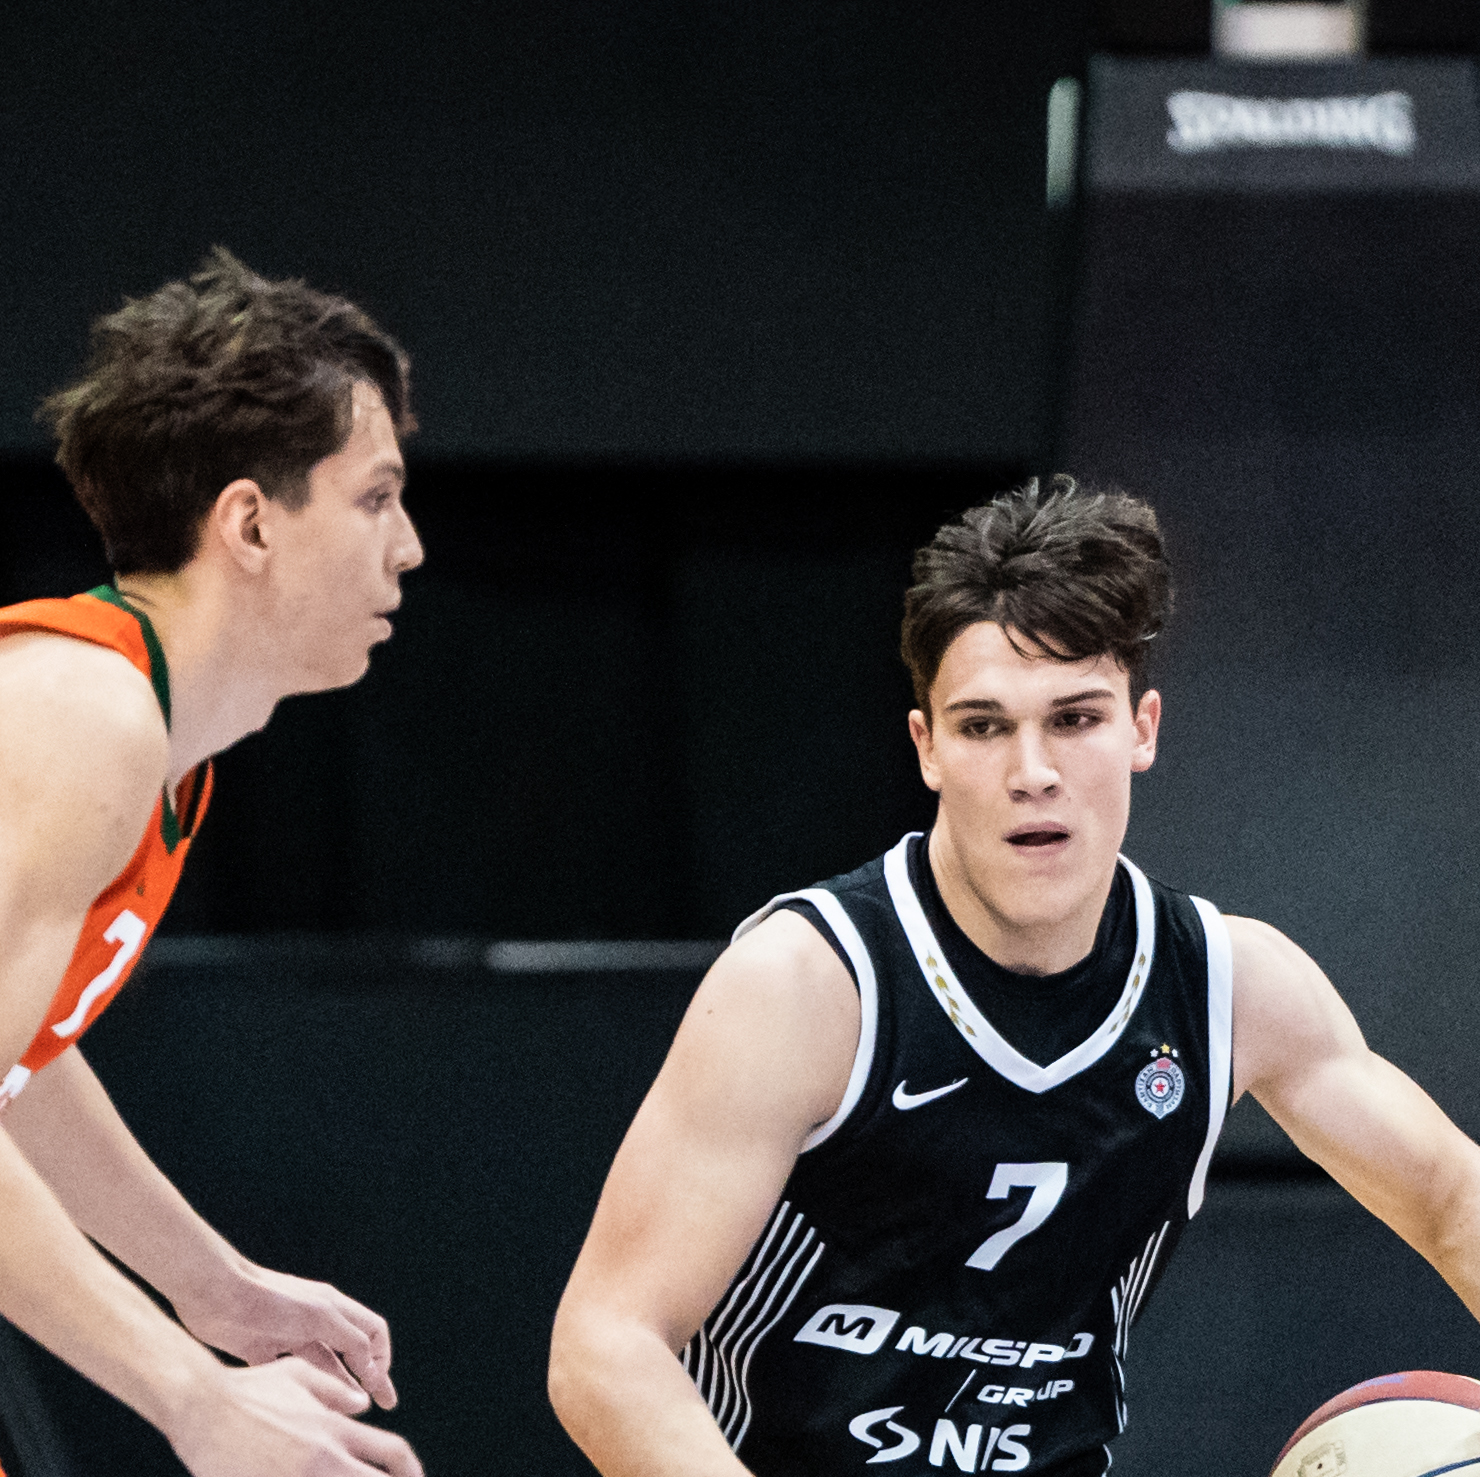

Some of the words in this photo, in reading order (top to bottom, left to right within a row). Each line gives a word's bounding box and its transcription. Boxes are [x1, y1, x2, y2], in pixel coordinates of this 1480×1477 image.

[1166, 91, 1414, 154] SPALDING
[51, 909, 146, 1038] 7
[965, 1162, 1069, 1270] 7
[928, 1418, 1031, 1474] NIS
